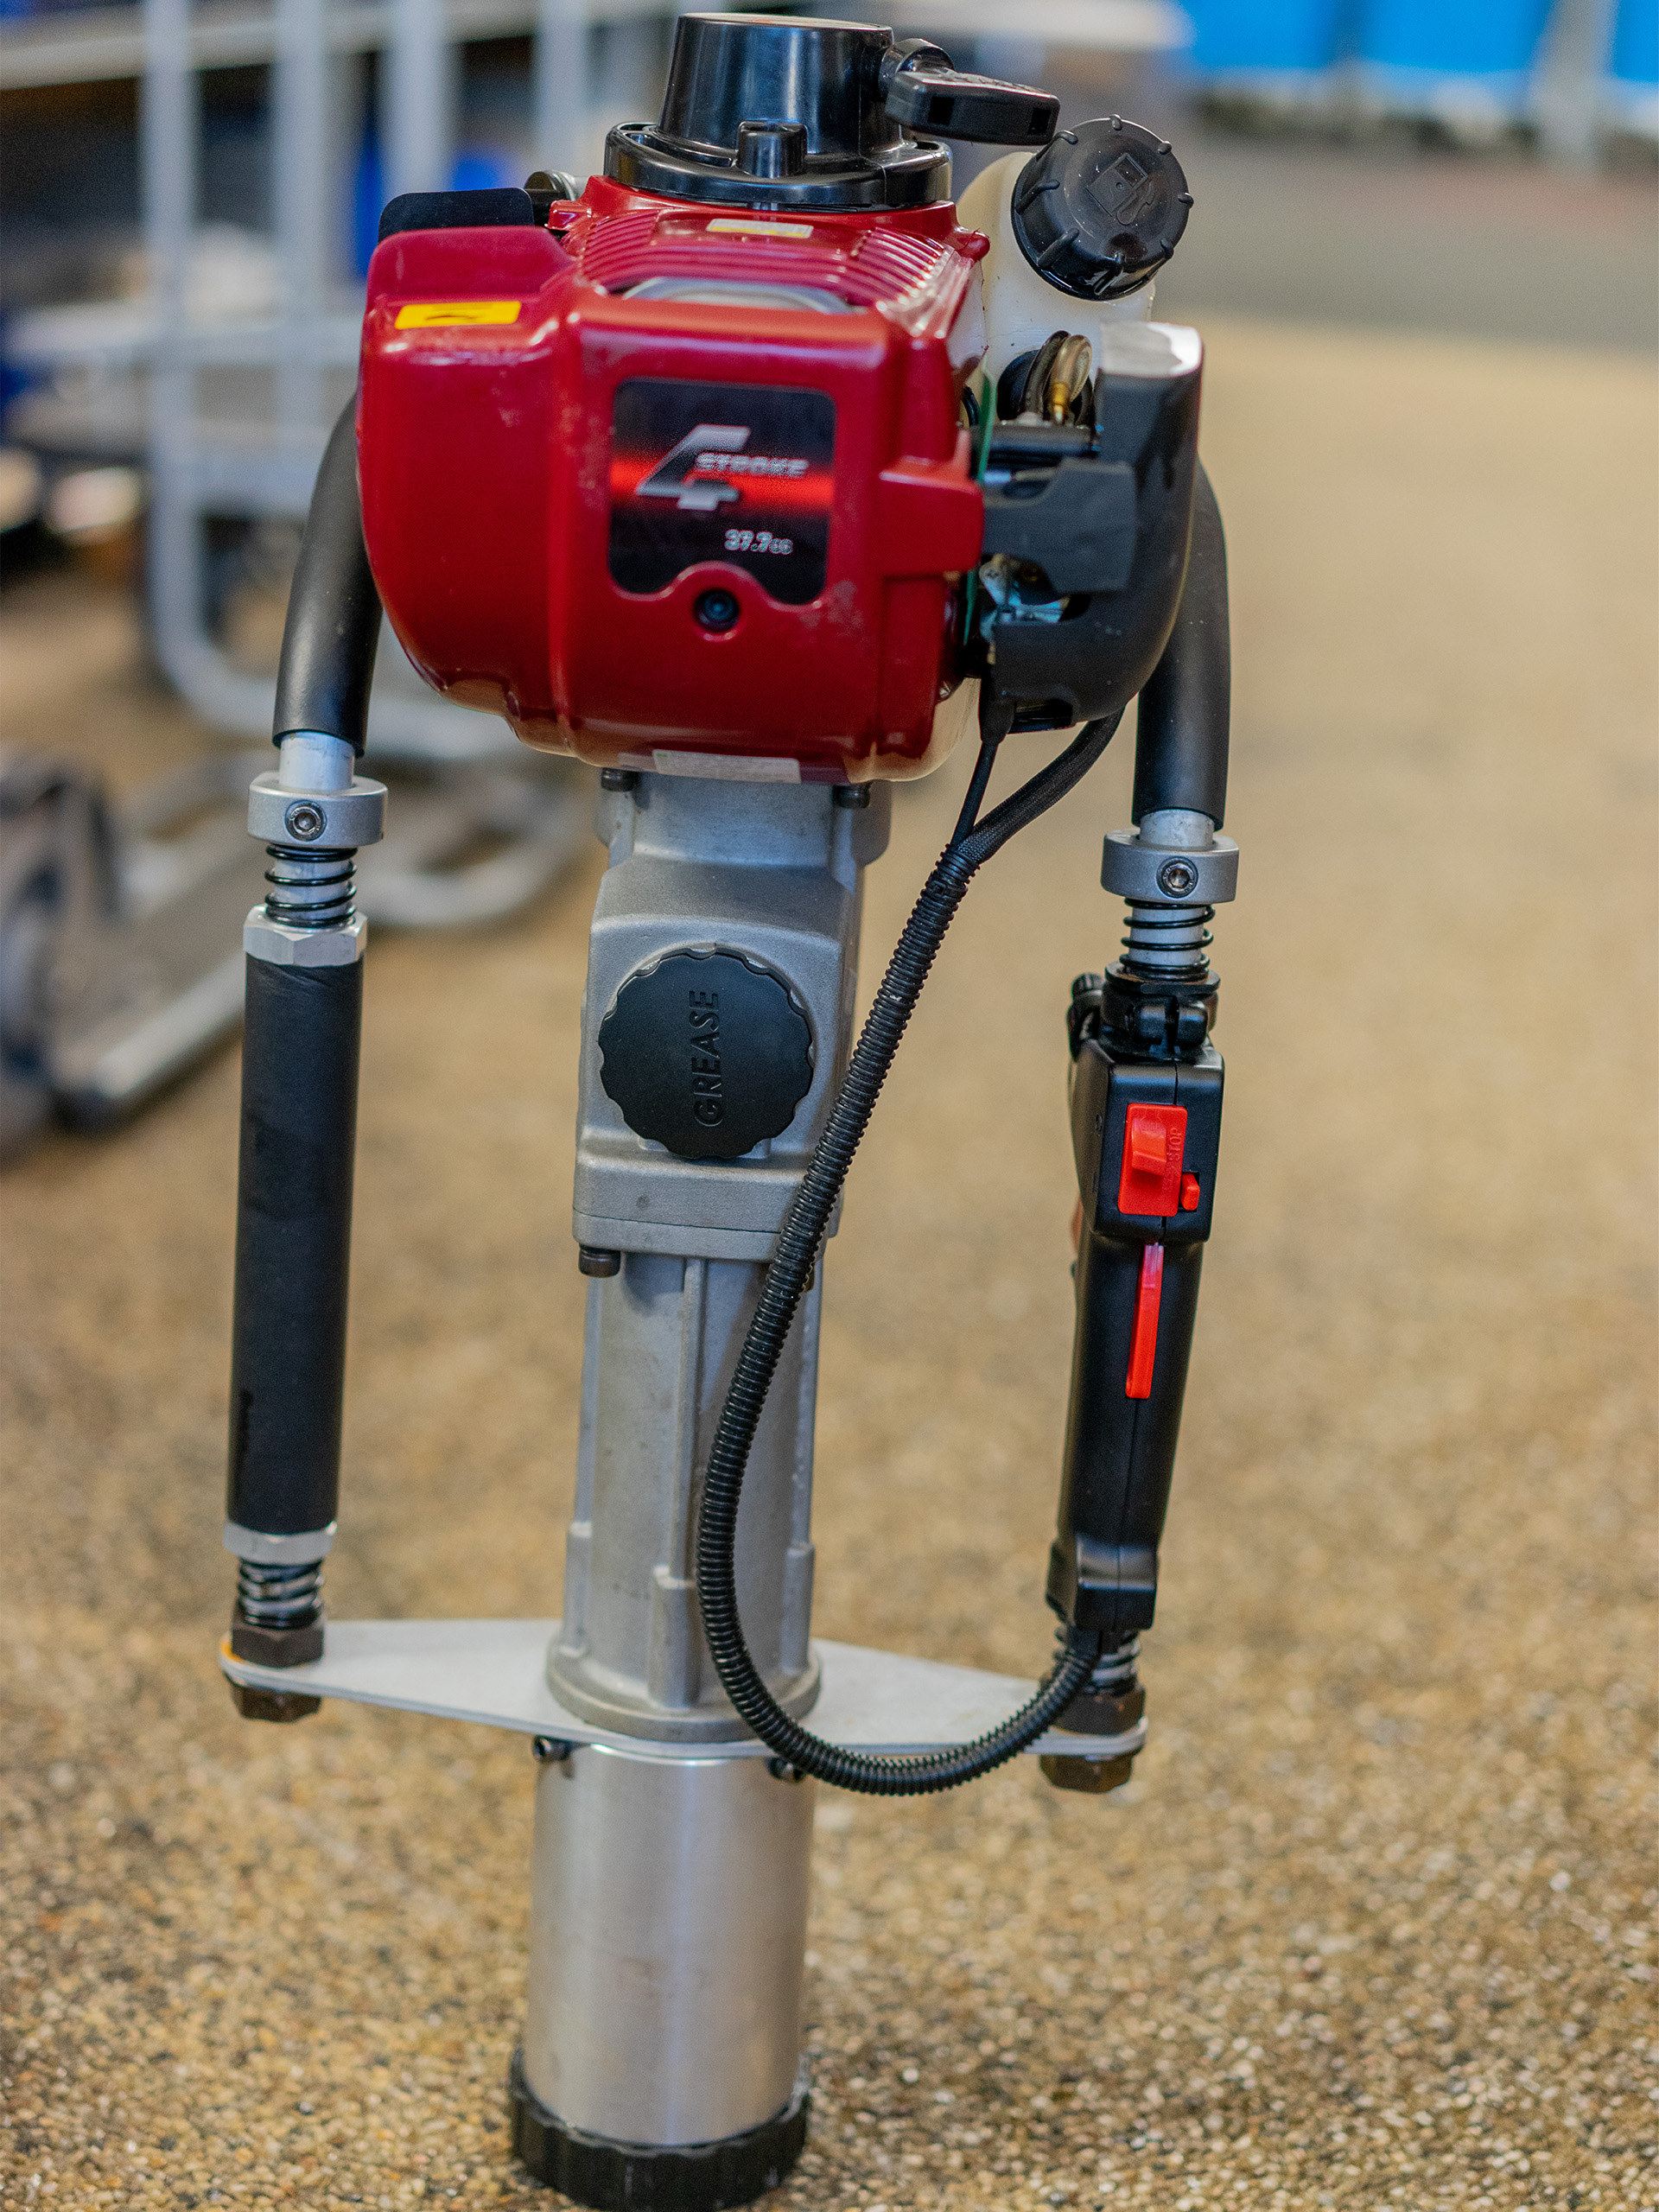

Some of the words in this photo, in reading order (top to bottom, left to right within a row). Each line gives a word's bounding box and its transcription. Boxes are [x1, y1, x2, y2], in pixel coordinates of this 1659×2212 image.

[636, 424, 750, 510] 4
[696, 452, 810, 478] STROKE
[690, 990, 723, 1127] GREASE
[1166, 1127, 1182, 1161] STOP
